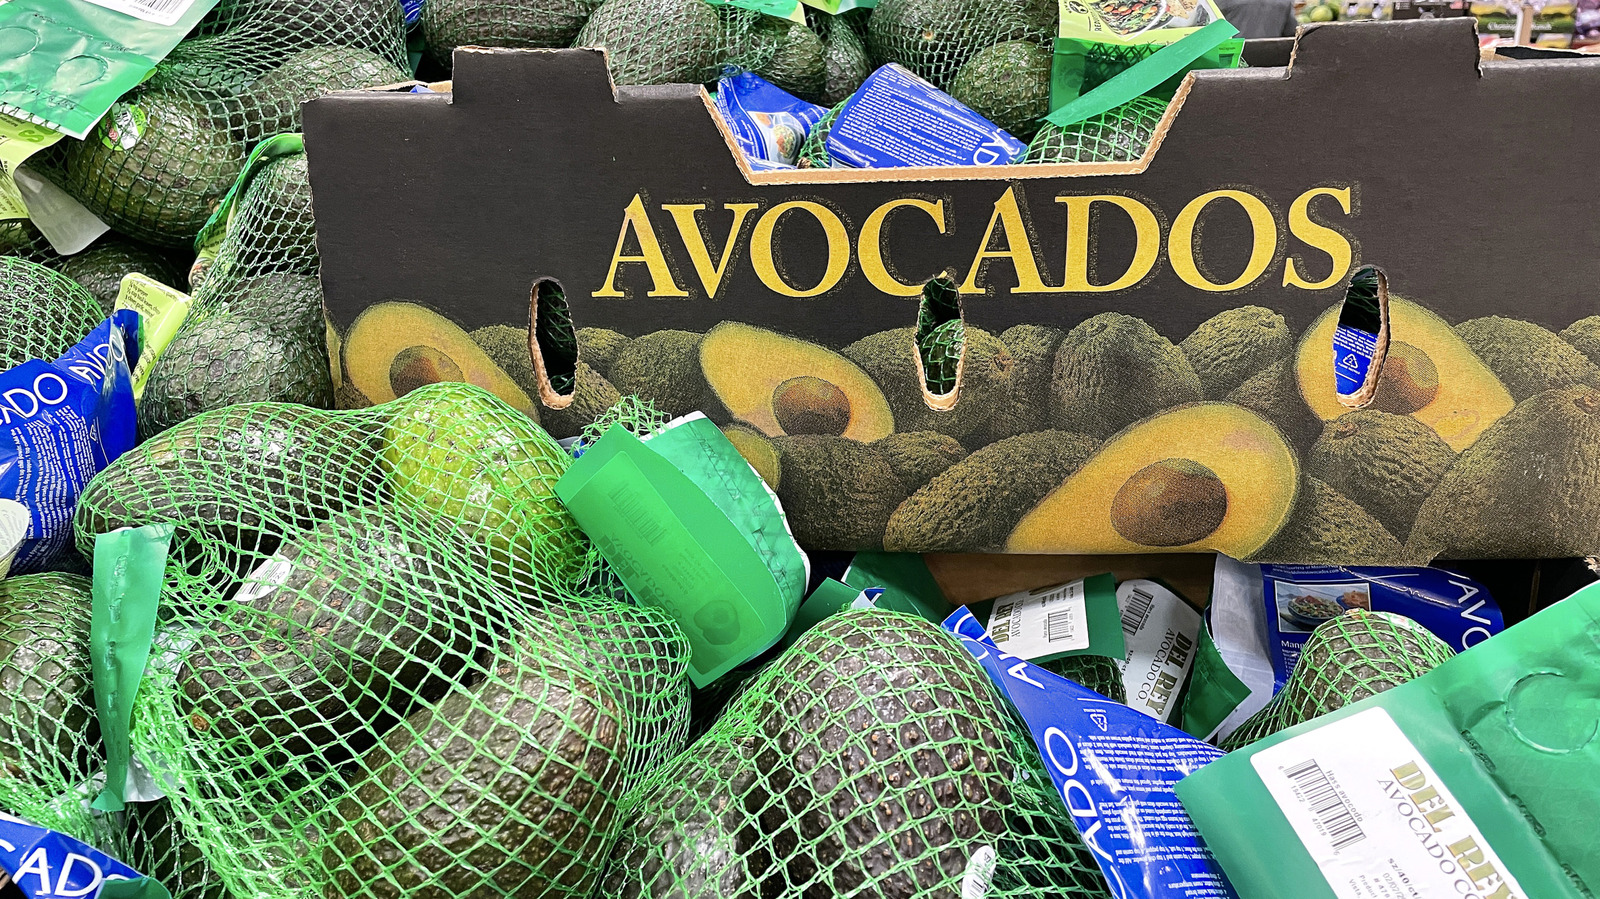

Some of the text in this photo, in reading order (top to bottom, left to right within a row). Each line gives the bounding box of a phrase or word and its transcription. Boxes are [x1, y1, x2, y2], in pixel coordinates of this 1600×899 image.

[591, 186, 1353, 299] AVOCADOS
[1136, 628, 1175, 701] AVOCADO CO.
[1146, 631, 1193, 715] DEL REY
[1326, 769, 1341, 789] Hass
[1389, 760, 1456, 834] DEL
[1377, 779, 1456, 875] AVOCADO
